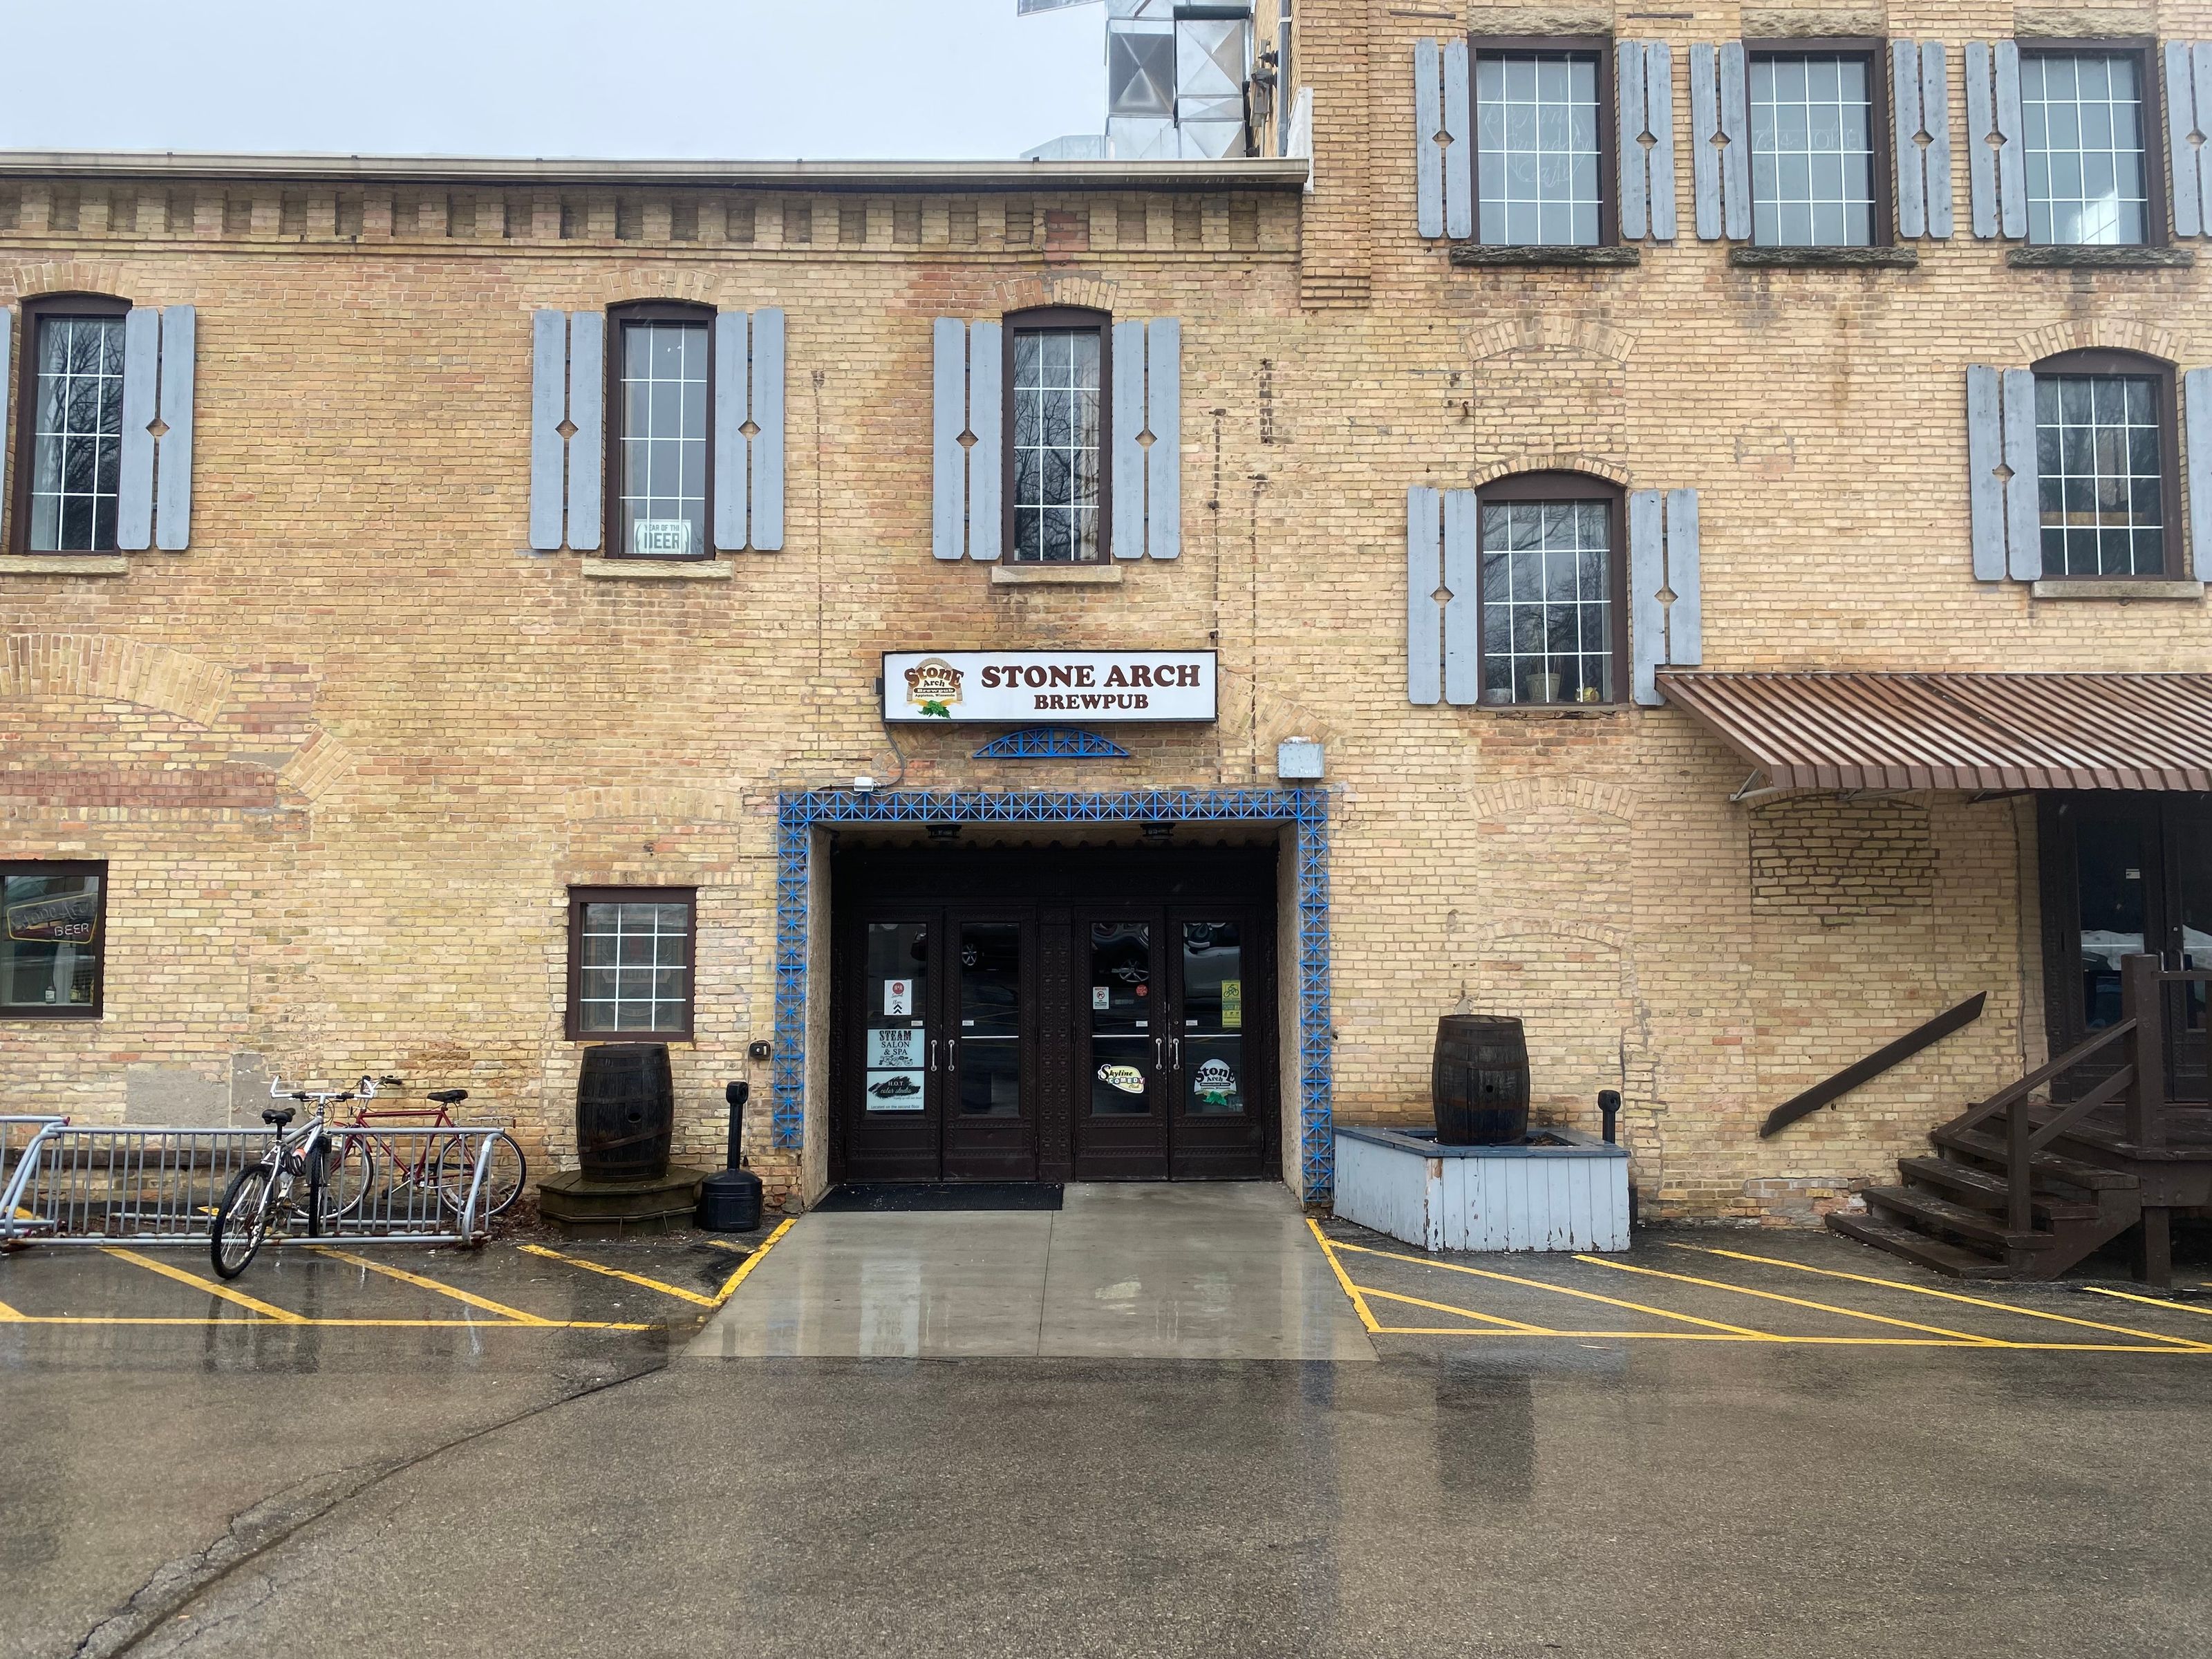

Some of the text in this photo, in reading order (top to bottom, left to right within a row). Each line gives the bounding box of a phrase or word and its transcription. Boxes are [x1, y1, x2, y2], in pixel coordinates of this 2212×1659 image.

[644, 532, 680, 549] DEER
[981, 664, 1201, 688] STONE ARCH
[1034, 694, 1149, 709] BREWPUB
[54, 923, 89, 937] BEER
[879, 1030, 912, 1041] STEAM
[1098, 1065, 1133, 1080] Skyline
